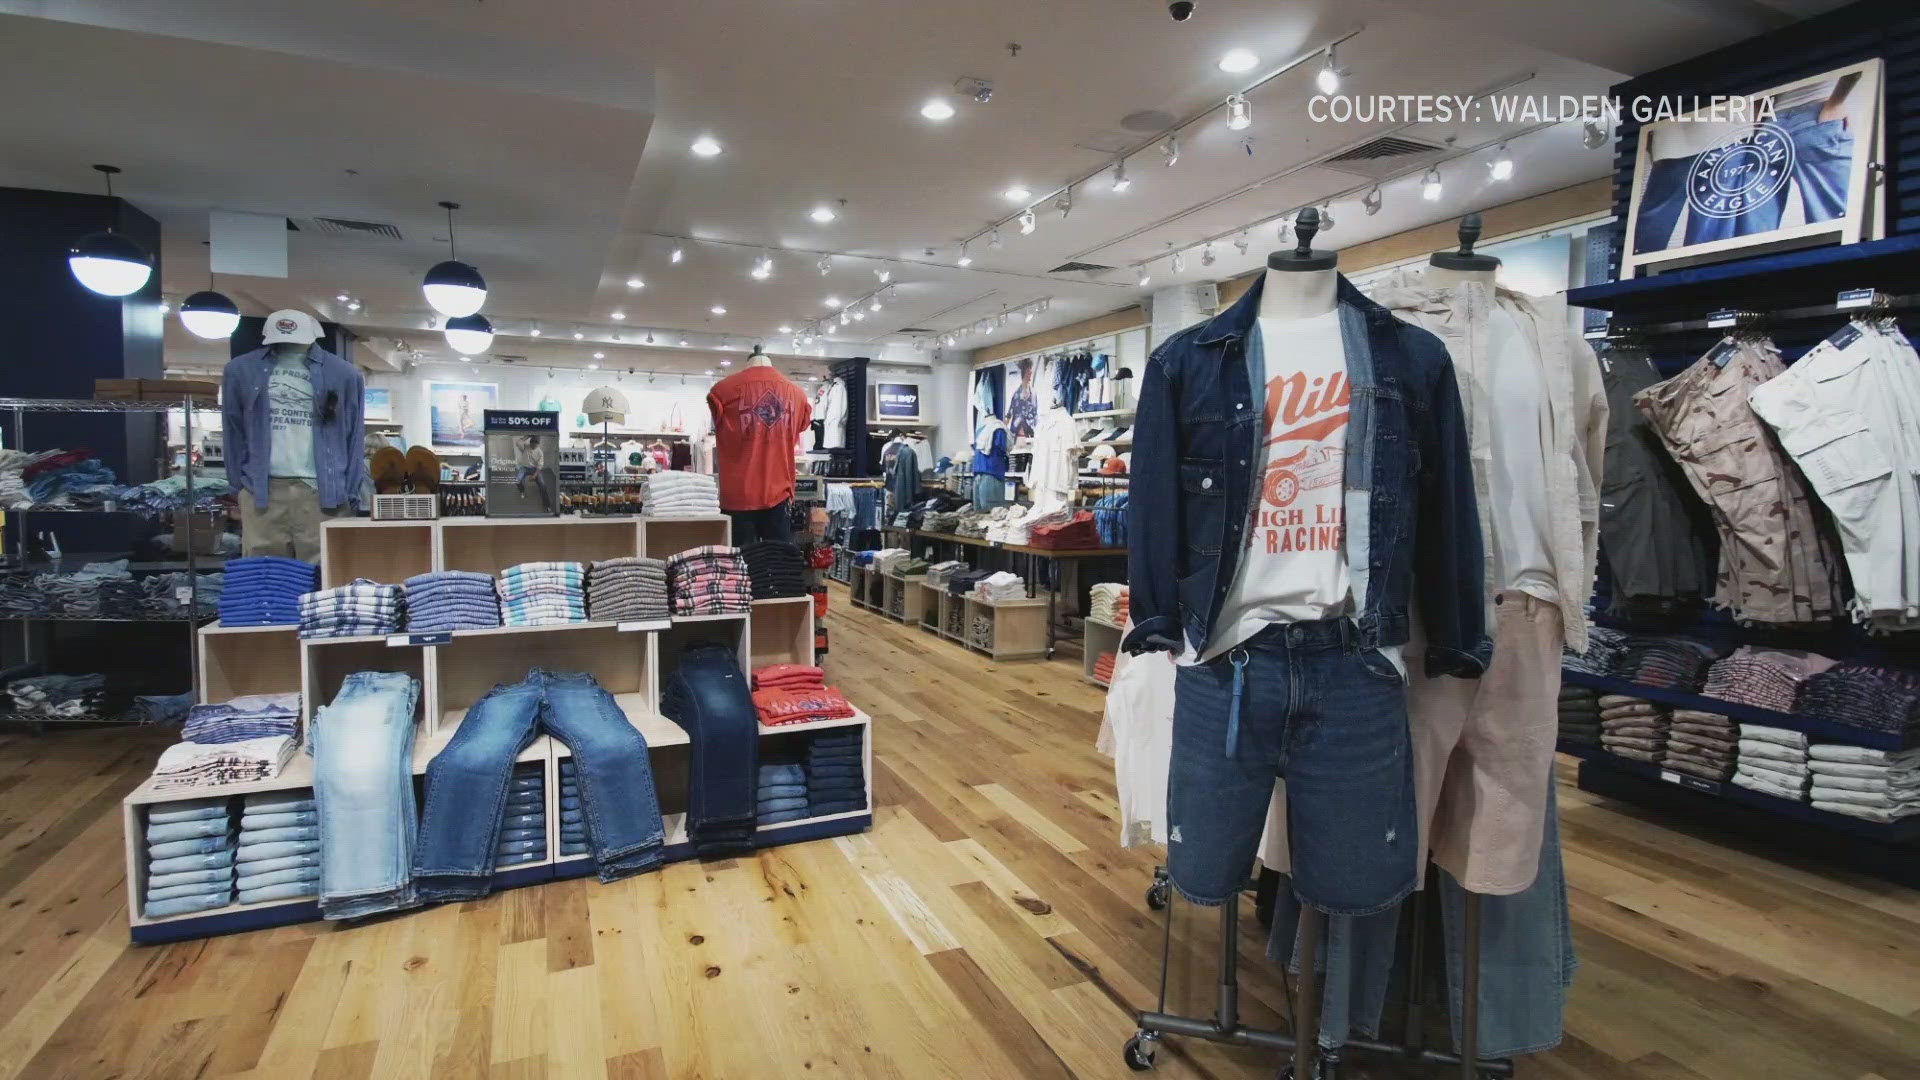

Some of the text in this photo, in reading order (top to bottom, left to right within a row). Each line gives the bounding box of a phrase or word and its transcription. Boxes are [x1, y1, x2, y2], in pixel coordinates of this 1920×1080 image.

[1697, 132, 1785, 179] AMERICAN
[1723, 163, 1755, 178] 1977
[1704, 183, 1770, 211] EAGLE
[508, 416, 530, 425] 50%
[531, 417, 552, 426] OFF
[1266, 526, 1342, 554] RACING
